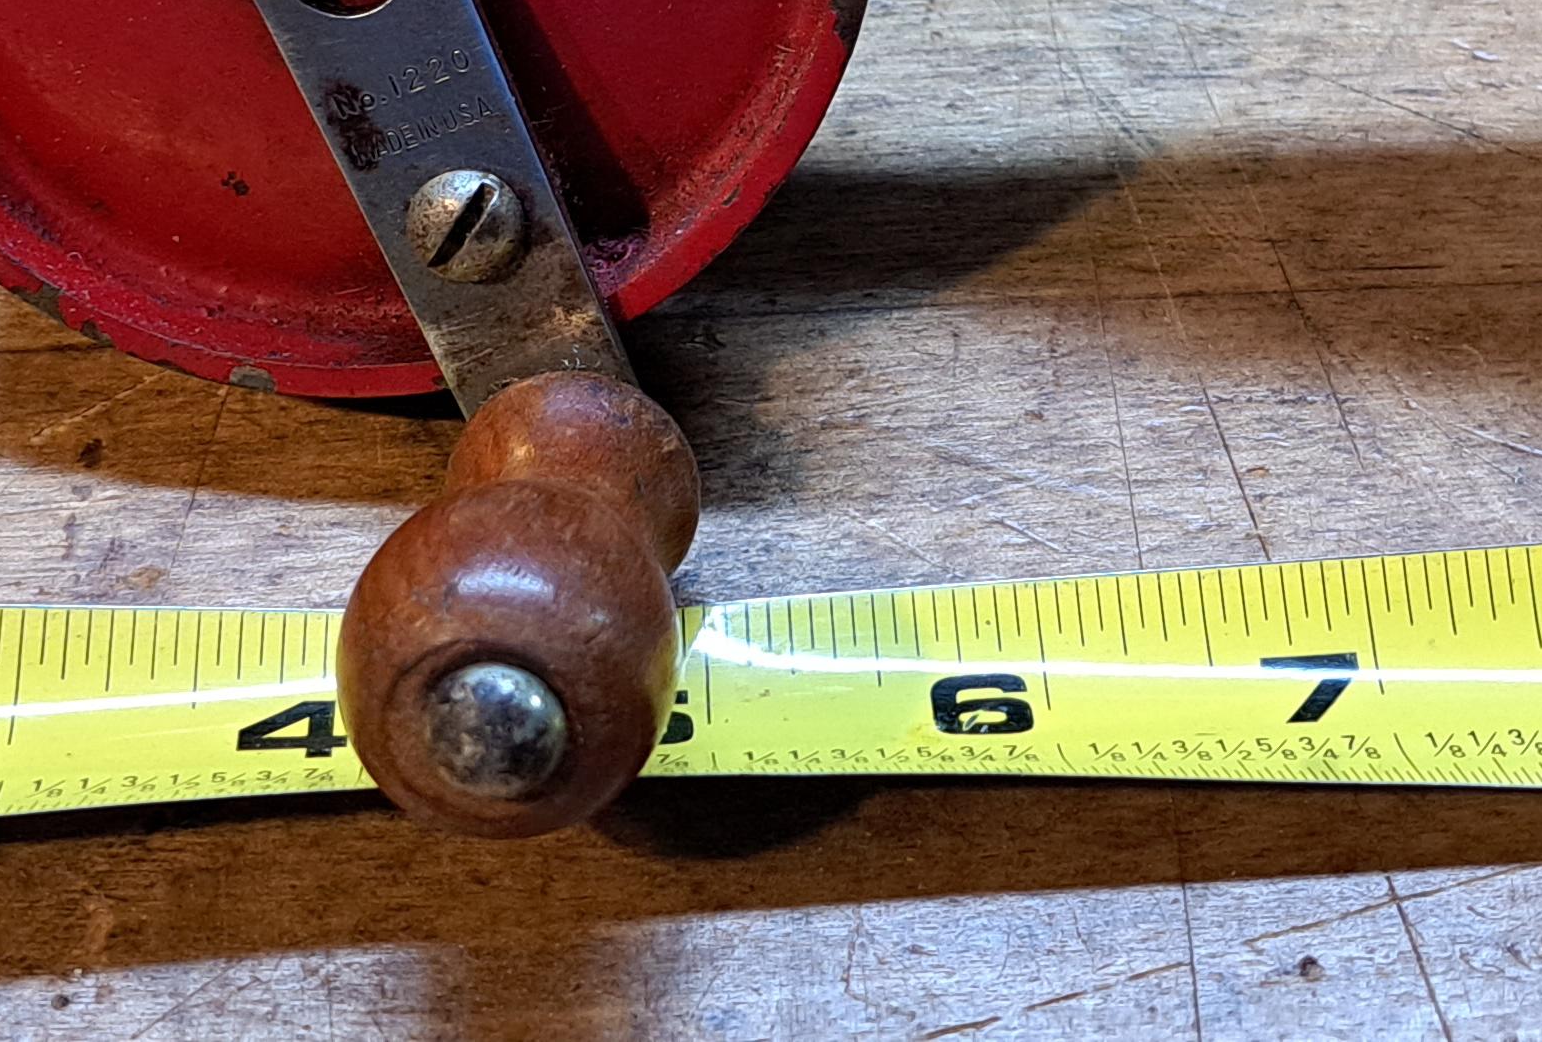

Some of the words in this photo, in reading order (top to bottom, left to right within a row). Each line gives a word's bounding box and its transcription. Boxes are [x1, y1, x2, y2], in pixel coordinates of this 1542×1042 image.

[417, 115, 442, 143] IN
[236, 700, 348, 758] 4
[930, 673, 1035, 735] 6
[1259, 652, 1359, 724] 7
[1088, 742, 1127, 762] 1/8
[1132, 741, 1173, 761] 1/4
[1172, 739, 1214, 761] 3/8
[1216, 738, 1256, 761] 1/2
[1255, 737, 1298, 760] 5/8
[1298, 736, 1340, 760] 3/4
[1341, 734, 1382, 760] 7/8
[1425, 732, 1466, 759] 1/8
[1467, 730, 1508, 757] 1/4
